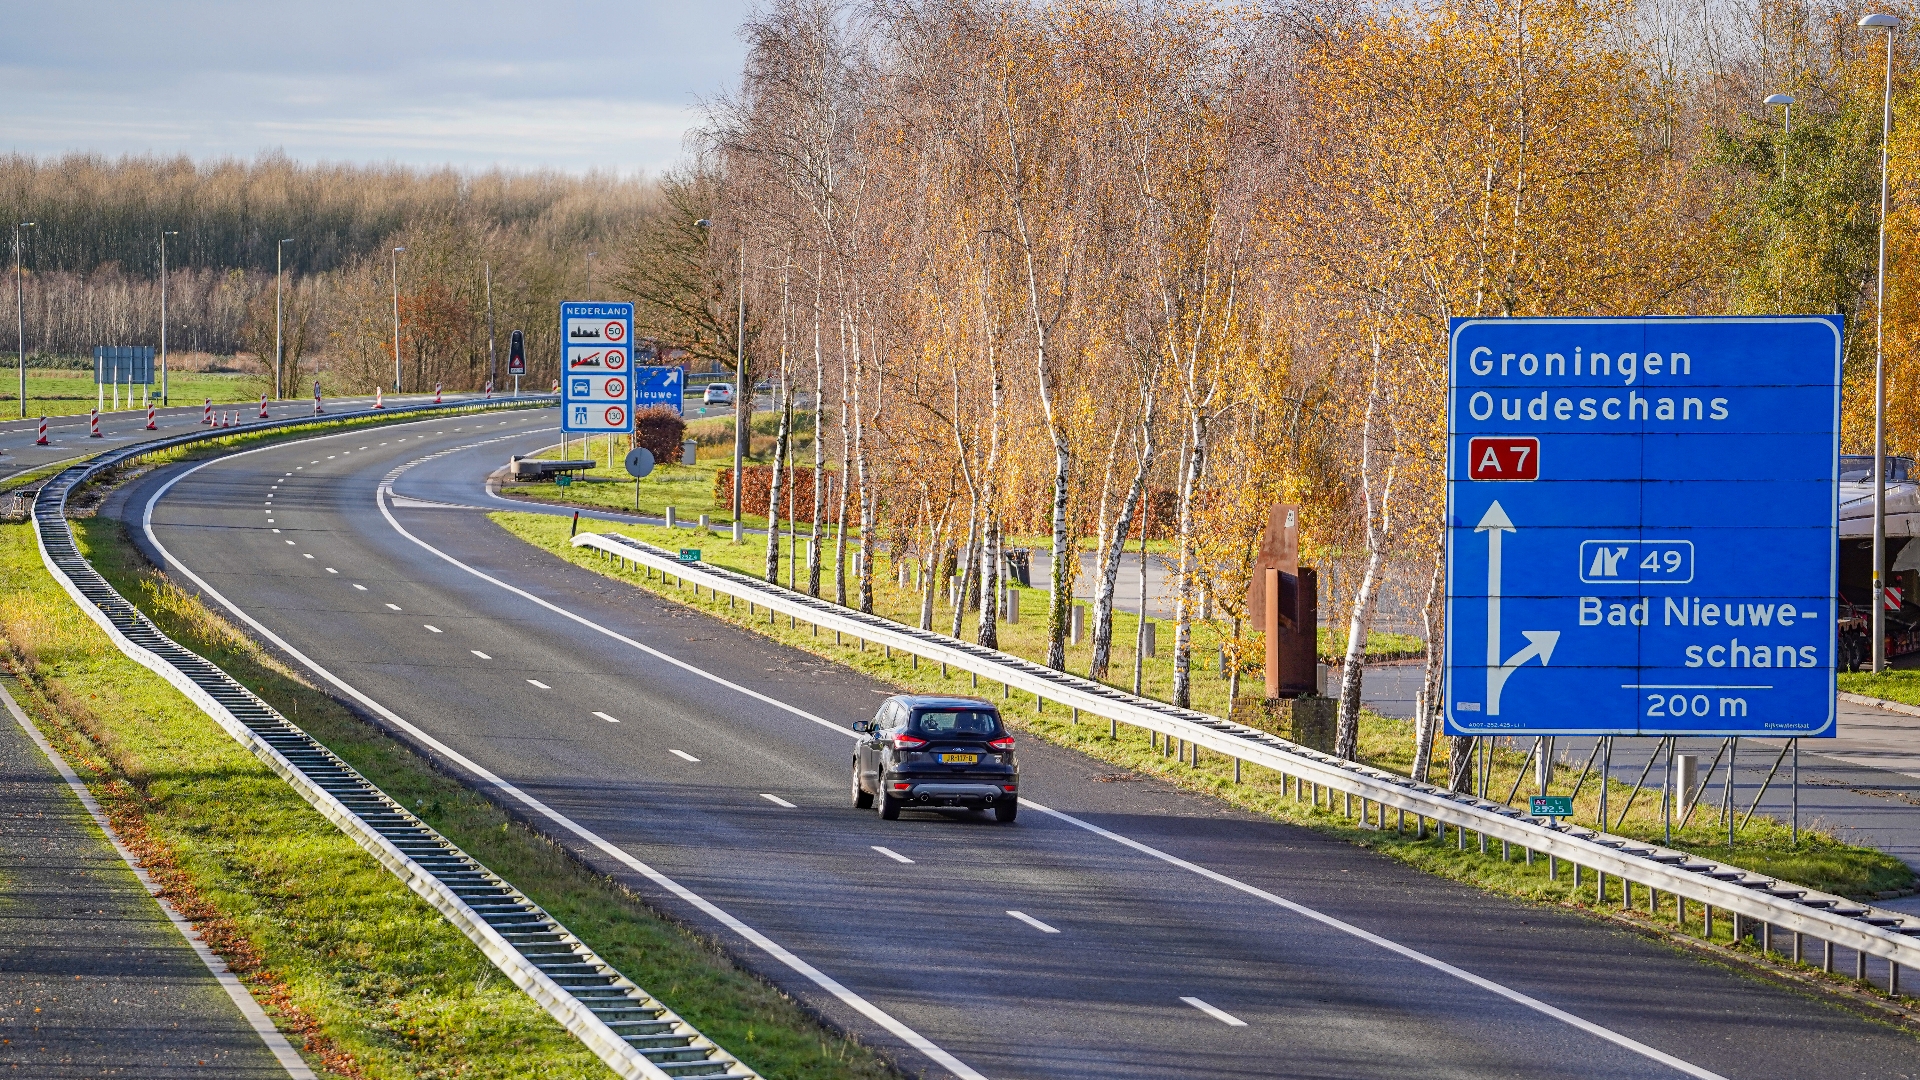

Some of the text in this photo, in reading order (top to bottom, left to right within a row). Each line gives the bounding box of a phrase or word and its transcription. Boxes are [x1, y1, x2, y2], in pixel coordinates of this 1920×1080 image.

[566, 307, 628, 315] NEDERLAND
[608, 327, 621, 335] 50
[608, 355, 621, 363] 80
[1469, 346, 1692, 385] Groningen
[608, 383, 621, 391] 100
[608, 411, 621, 420] 130
[1469, 390, 1729, 421] Oudeschans
[1477, 446, 1531, 472] A 7
[1639, 550, 1682, 573] 49
[1578, 597, 1818, 626] Bad Nieuwe-
[1684, 638, 1818, 668] schans
[1646, 694, 1748, 717] 200 m
